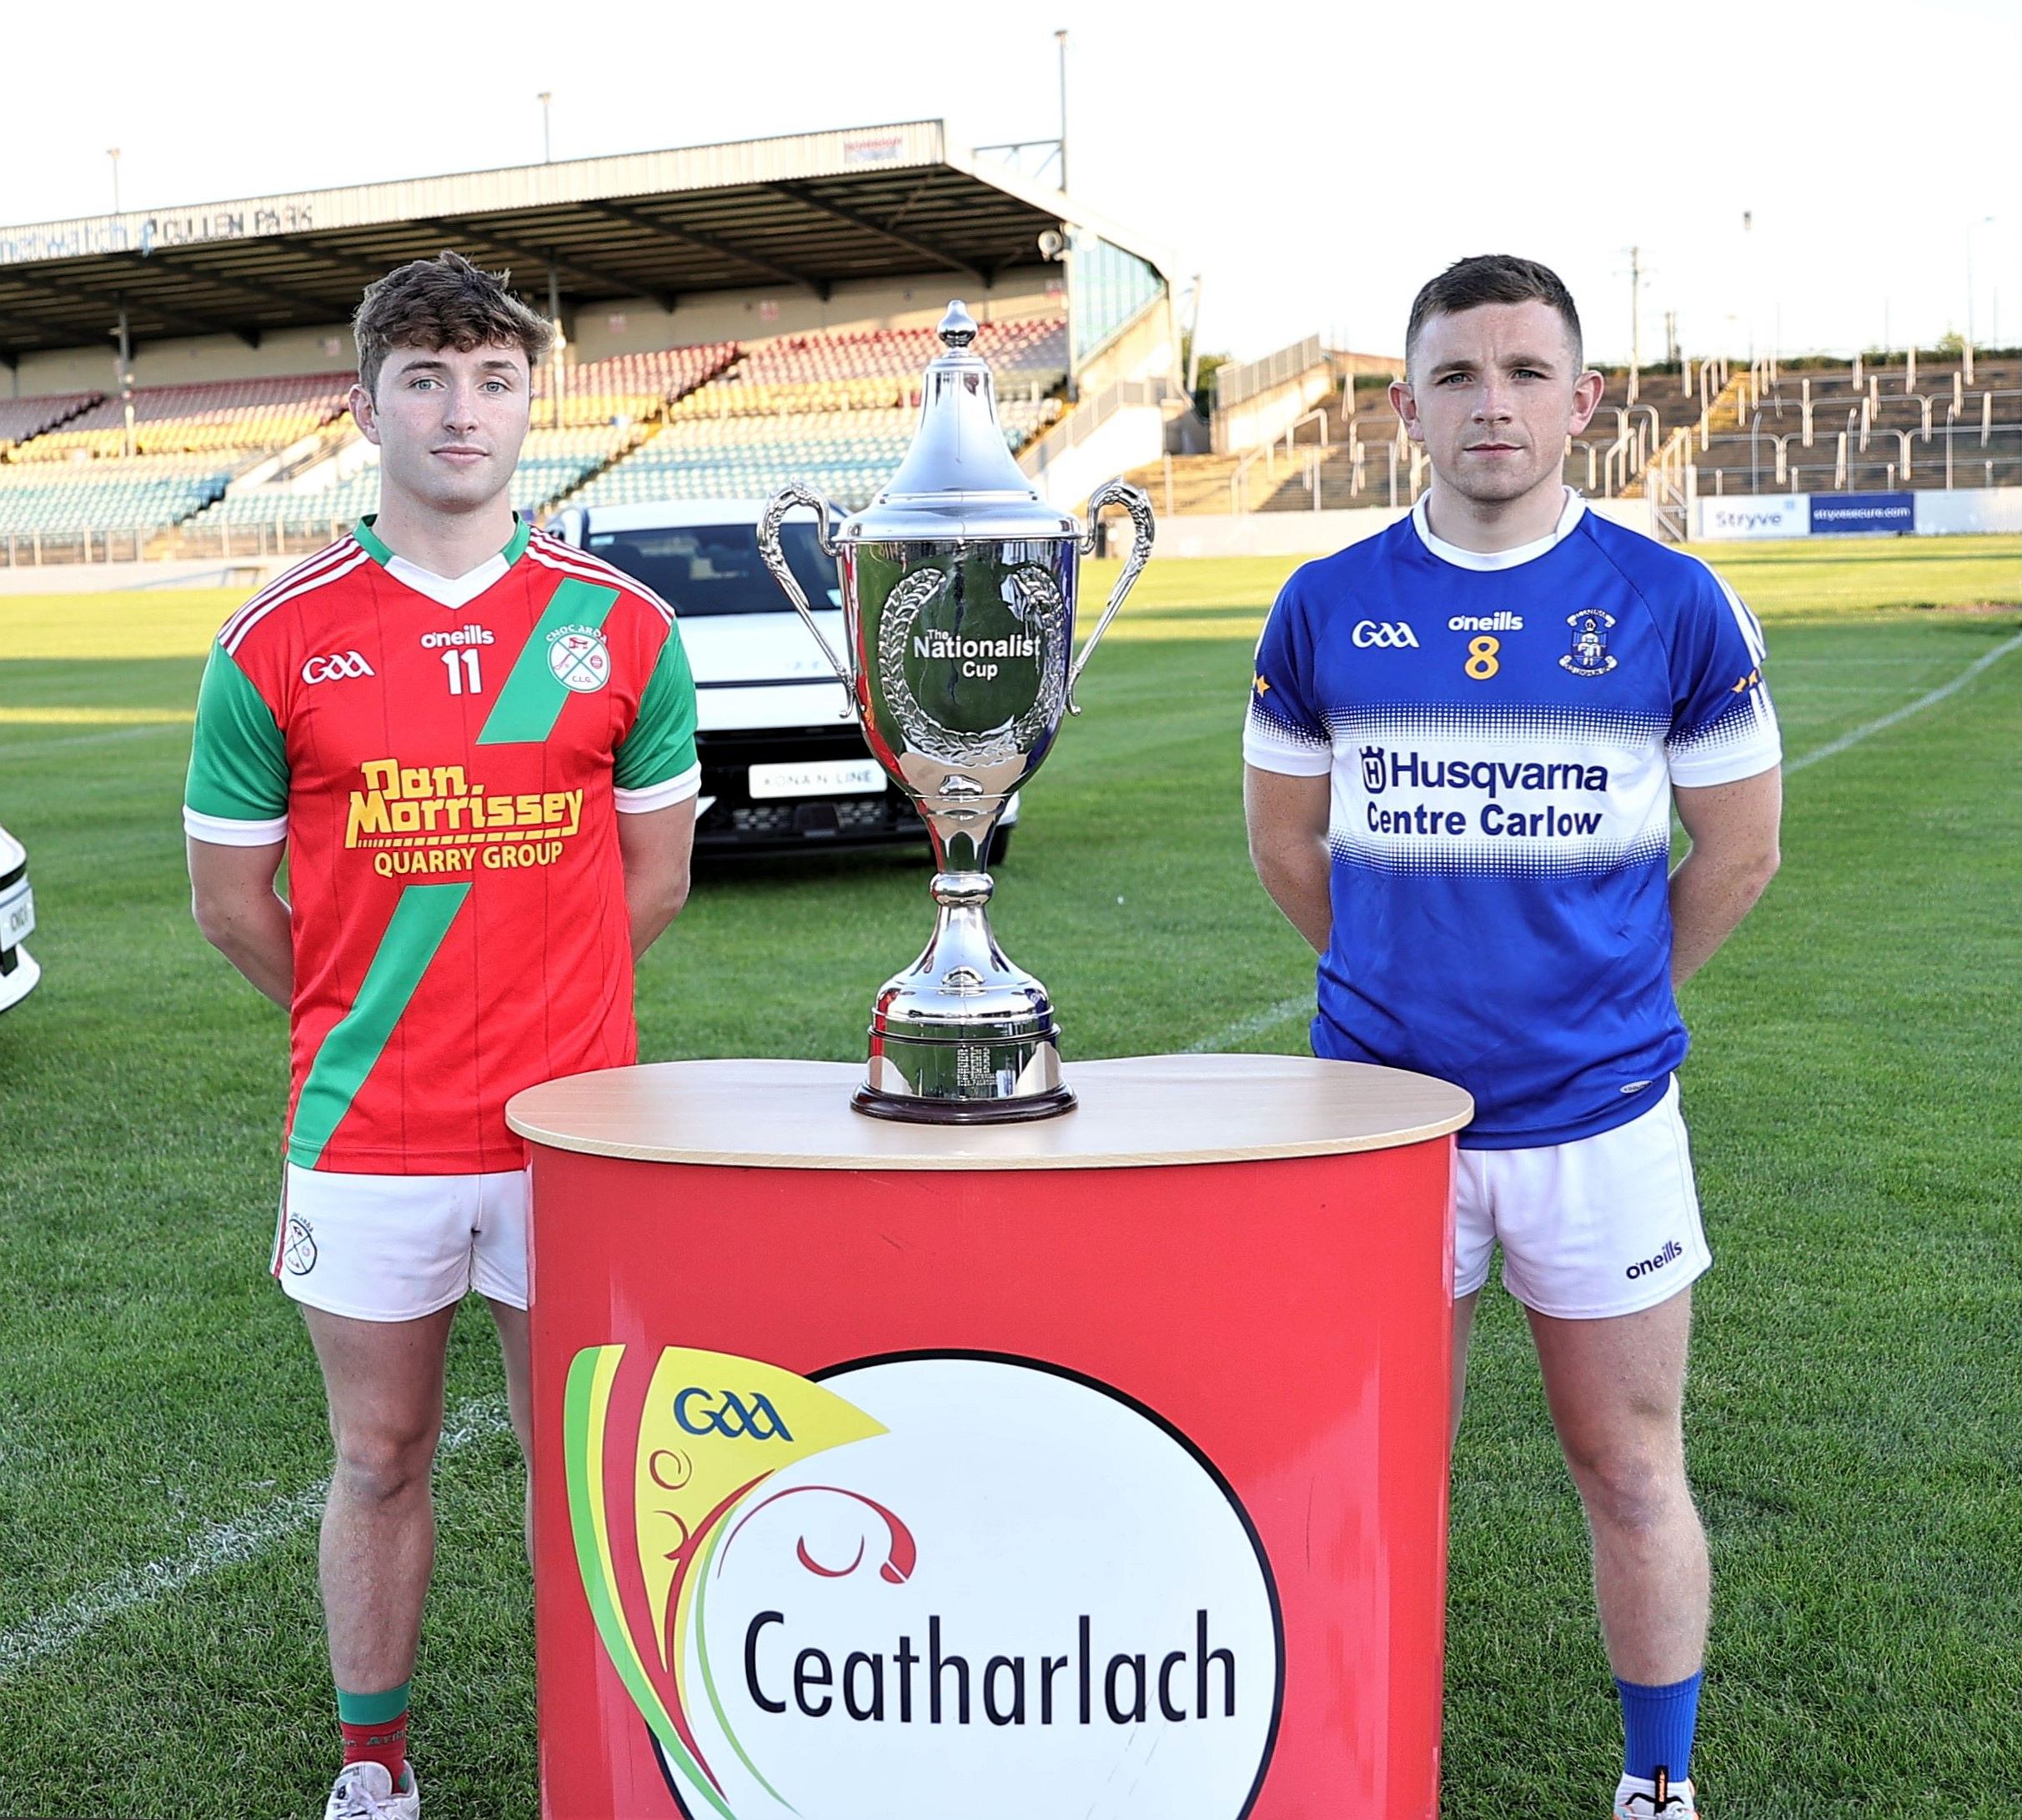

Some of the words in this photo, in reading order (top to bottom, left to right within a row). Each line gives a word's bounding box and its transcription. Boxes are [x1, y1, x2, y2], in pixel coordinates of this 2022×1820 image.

[253, 205, 313, 235] PARK
[1715, 509, 1783, 529] Stryve
[913, 634, 1041, 659] Nationalist
[926, 629, 949, 640] The
[440, 649, 484, 695] 11
[962, 660, 998, 680] Cup
[1464, 635, 1500, 679] 8
[360, 758, 468, 798] Dan
[1391, 752, 1608, 798] Husqvarna
[344, 785, 583, 848] Morrissey
[1367, 801, 1467, 835] Centre
[1480, 805, 1603, 836] Carlow
[374, 846, 475, 878] QUARRY
[482, 841, 564, 870] GROUP
[744, 1609, 1236, 1726] Ceatharlach
